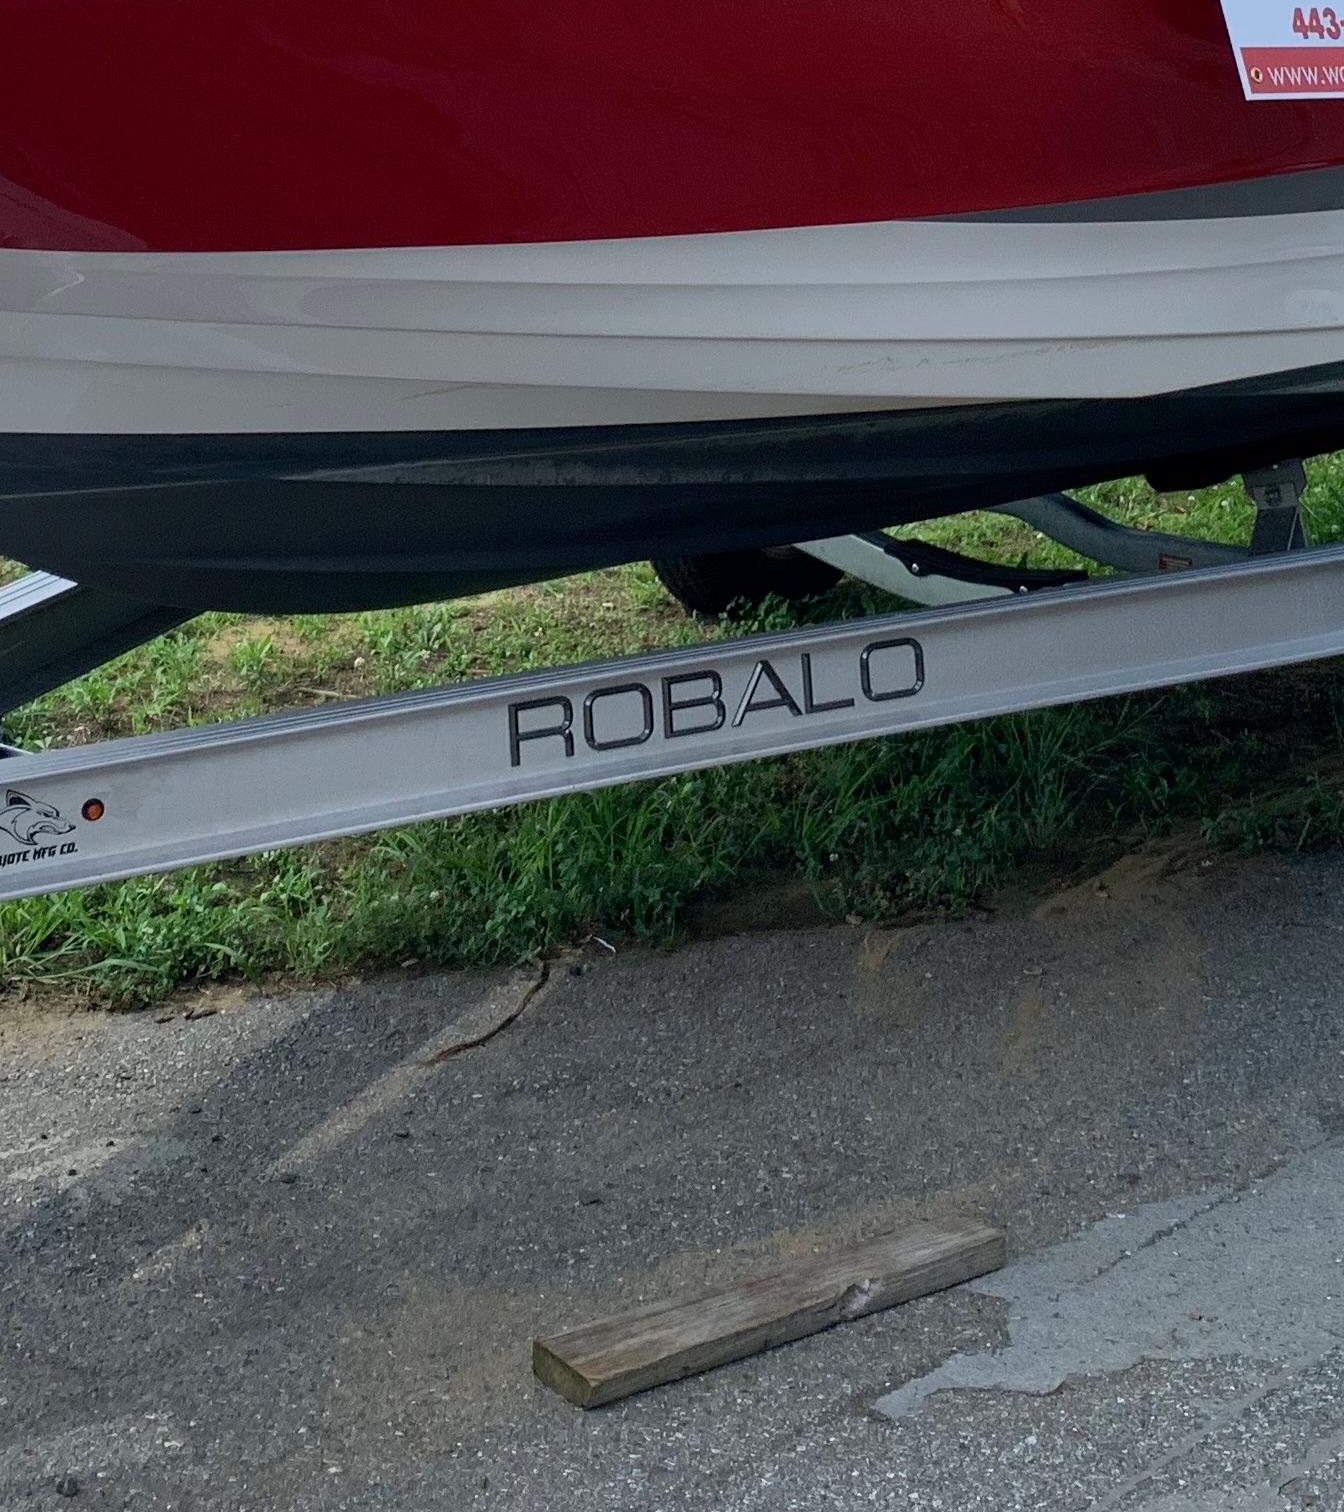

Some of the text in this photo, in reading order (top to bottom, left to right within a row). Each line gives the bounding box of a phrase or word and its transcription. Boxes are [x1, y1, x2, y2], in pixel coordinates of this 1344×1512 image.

[507, 636, 926, 768] ROBALO
[33, 845, 57, 860] MFG
[59, 842, 78, 856] CO.
